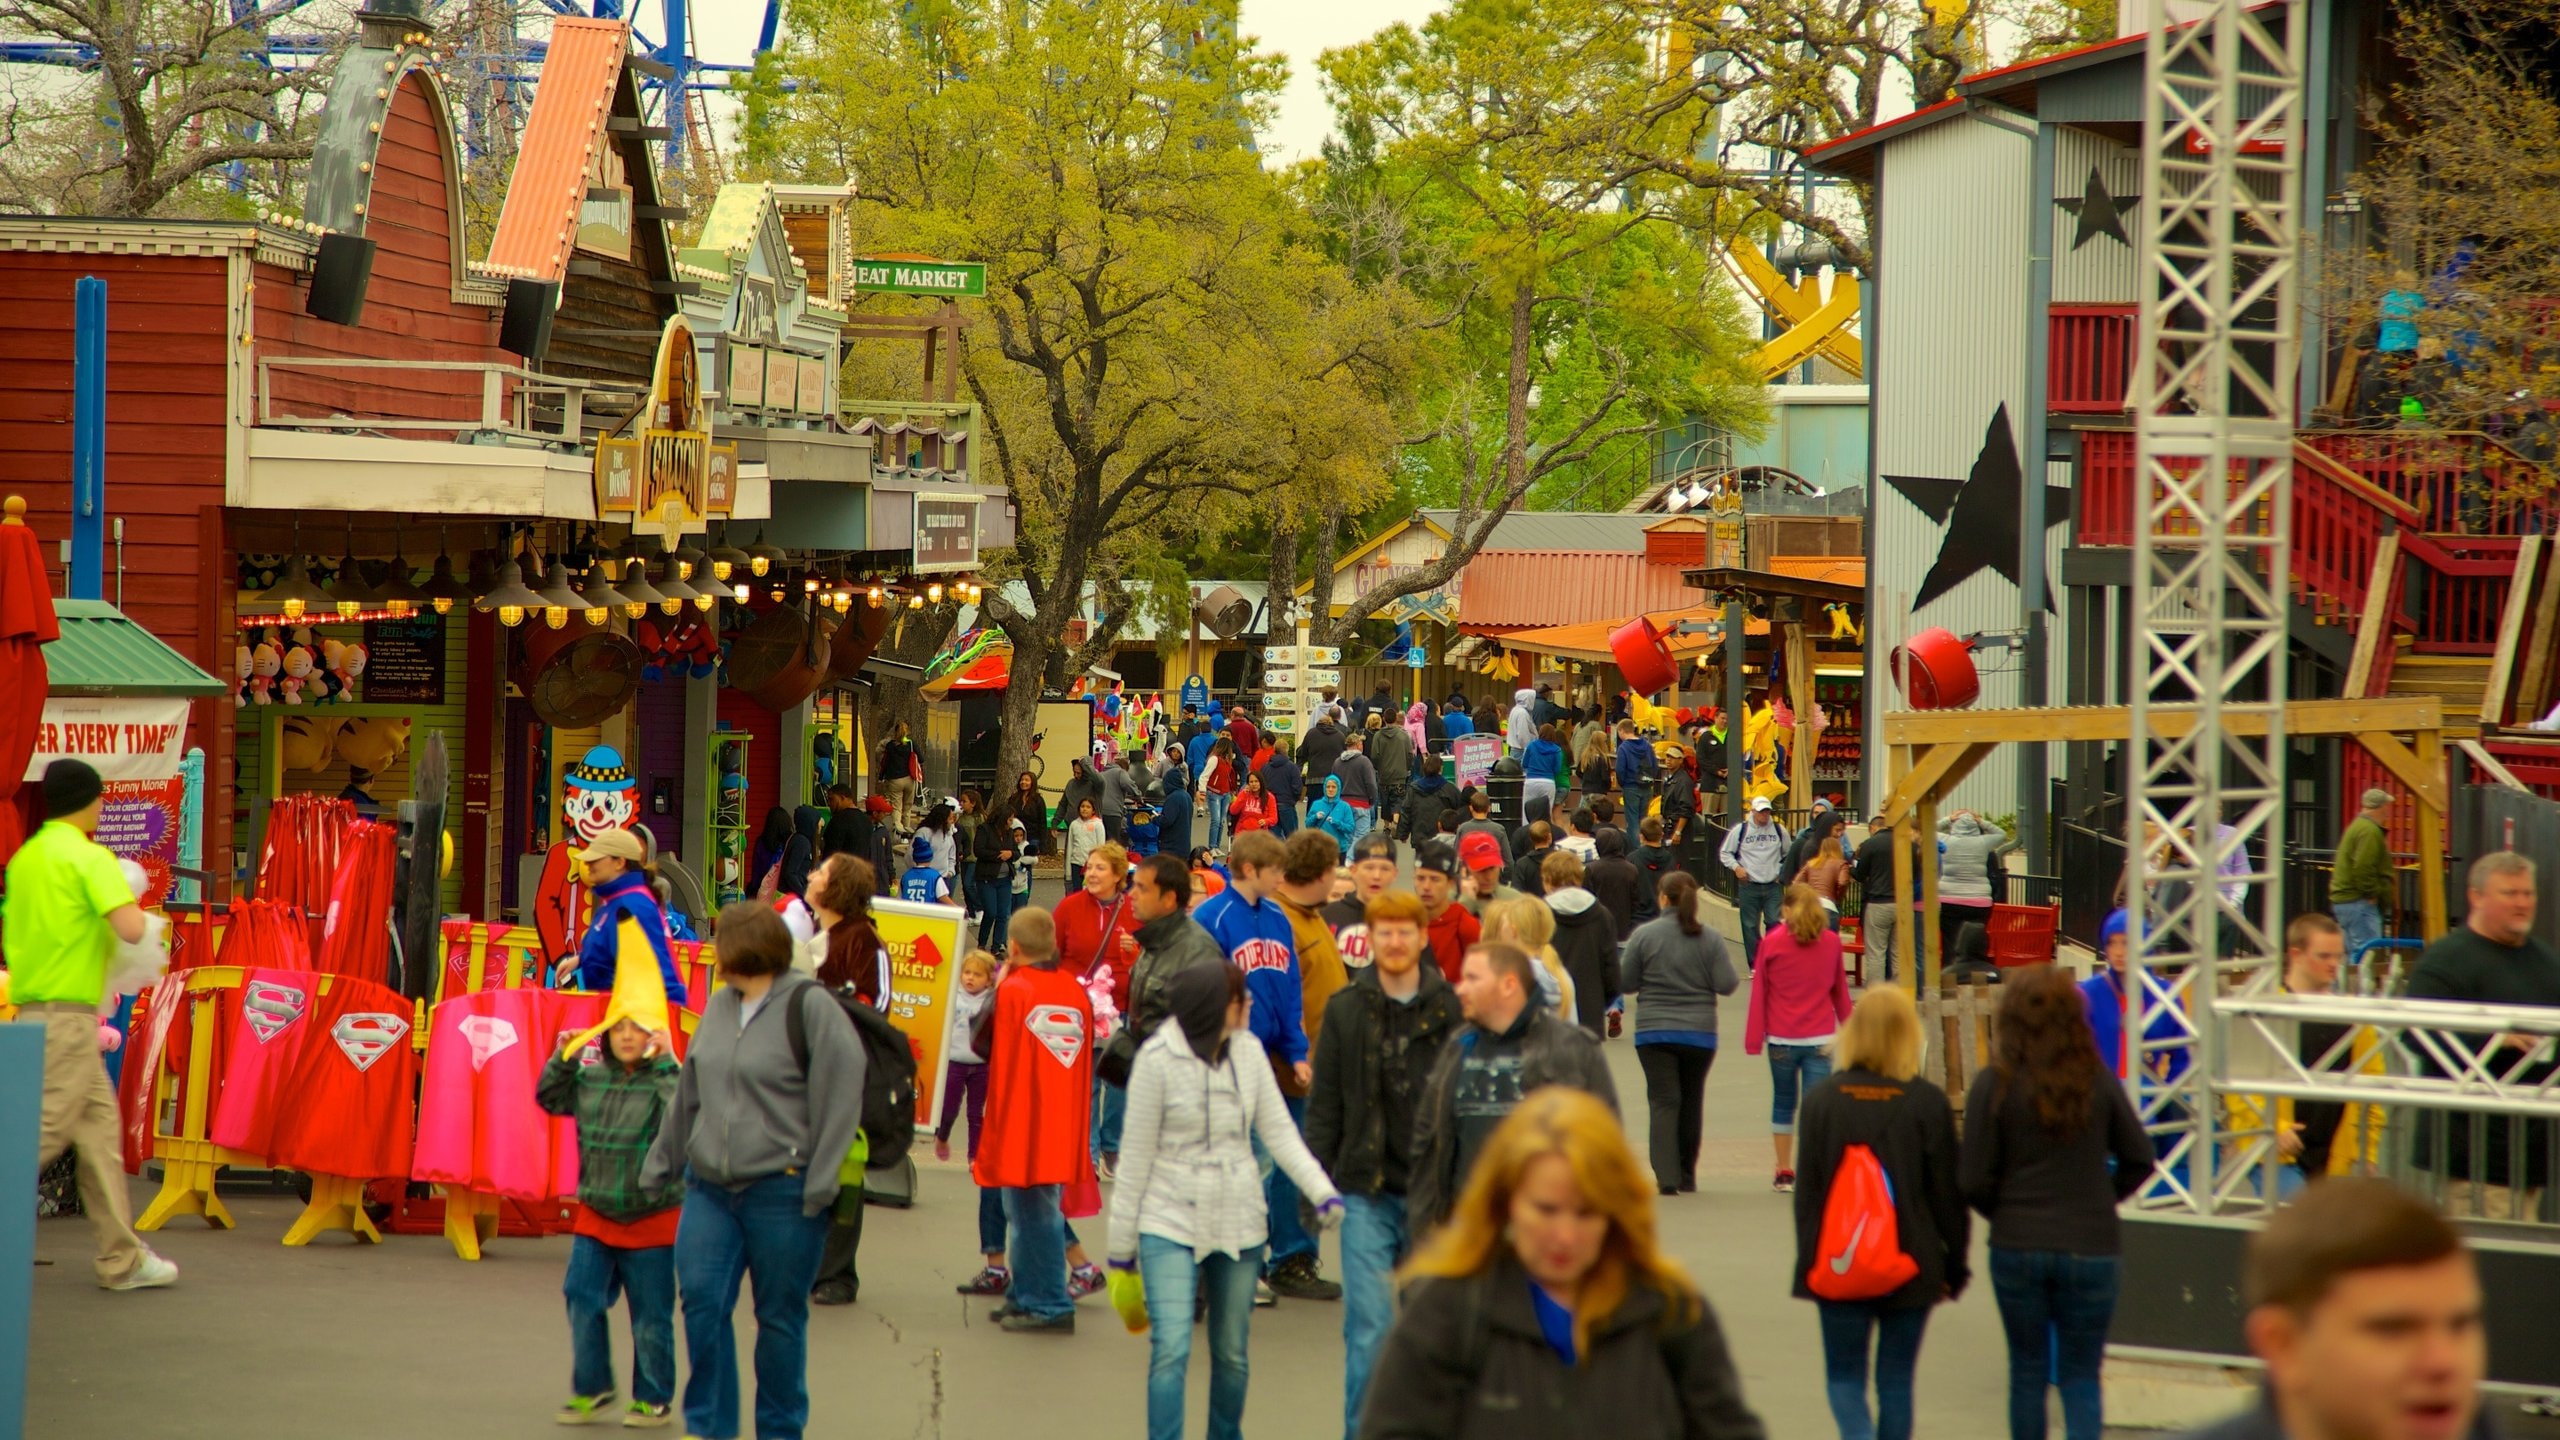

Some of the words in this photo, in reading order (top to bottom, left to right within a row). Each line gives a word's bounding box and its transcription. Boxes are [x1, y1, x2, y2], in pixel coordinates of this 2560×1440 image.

[894, 267, 968, 289] MARKET
[649, 436, 700, 513] SALOON
[34, 723, 60, 754] ER
[64, 723, 120, 754] EVERY
[113, 780, 140, 794] Funny
[141, 779, 169, 792] Money
[105, 804, 121, 812] YOUR
[121, 803, 139, 812] CREDIT
[139, 802, 153, 810] CARD
[99, 814, 107, 822] TO
[107, 814, 121, 822] PLAY
[132, 813, 146, 821] YOUR
[96, 824, 123, 832] FAVORITE
[123, 824, 147, 832] MIDWAY
[110, 834, 122, 842] AND
[122, 833, 134, 841] GET
[134, 833, 150, 841] MORE
[109, 844, 124, 852] YOUR
[907, 888, 926, 904] 35
